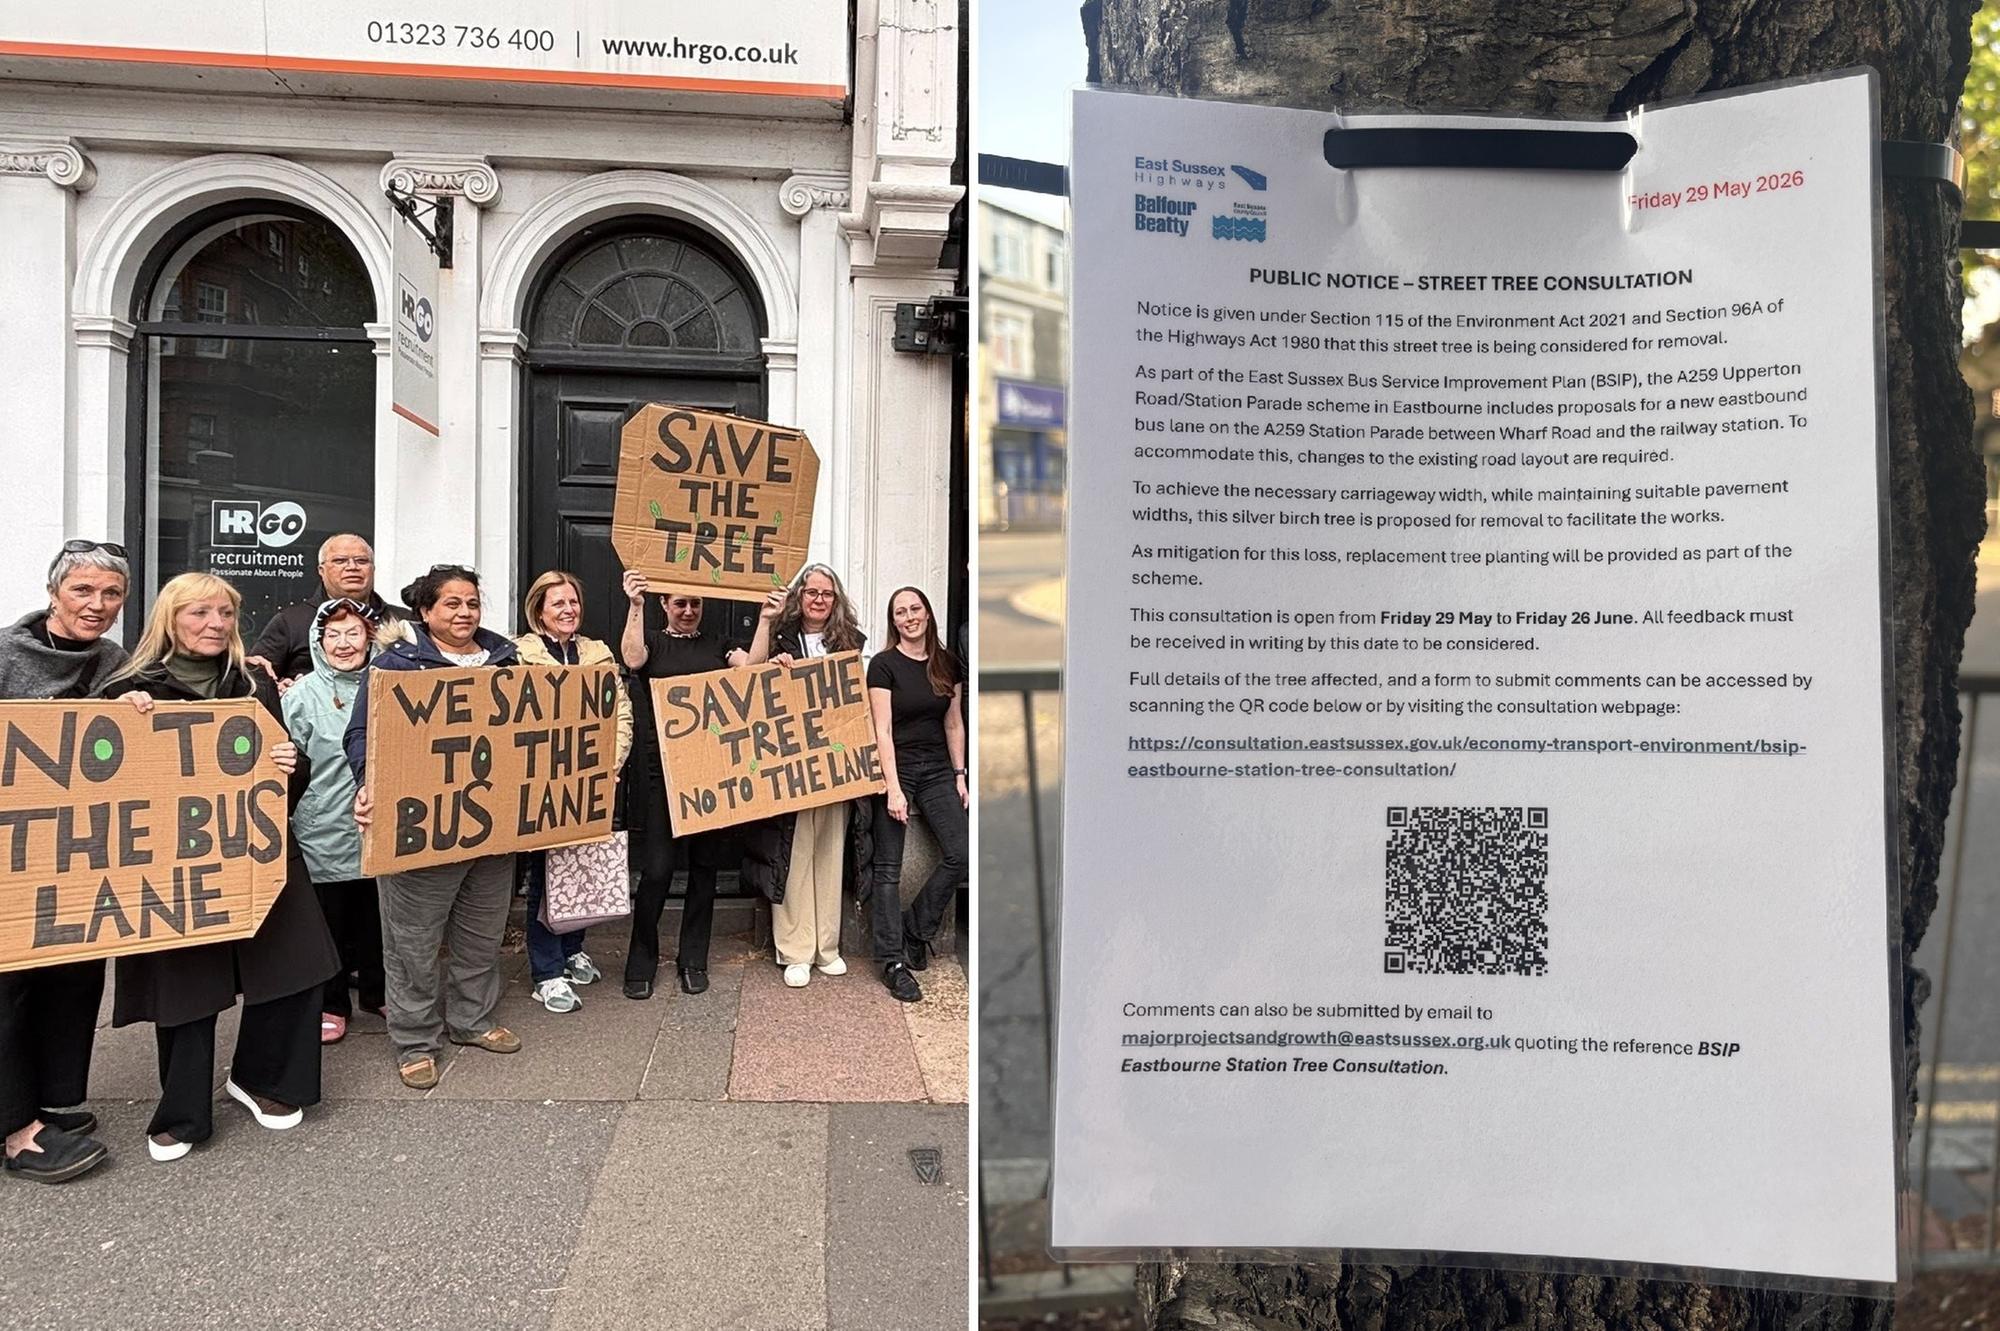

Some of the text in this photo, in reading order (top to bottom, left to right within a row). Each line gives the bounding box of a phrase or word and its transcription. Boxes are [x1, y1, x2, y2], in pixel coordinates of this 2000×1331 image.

[367, 21, 798, 66] 01323 736 400 www.hrgo.co.uk
[1135, 156, 1225, 177] East Sussex
[1135, 172, 1226, 191] Highways
[1135, 194, 1197, 216] Balfour
[1628, 170, 1804, 210] Friday 29 May 2026
[1135, 213, 1189, 237] Beatty
[1249, 267, 1322, 288] PUBLIC
[1326, 273, 1400, 291] NOTICE
[1417, 275, 1488, 291] STREET
[1491, 275, 1539, 292] TREE
[1543, 268, 1693, 292] CONSULTATION
[1137, 298, 1785, 329] Notice is given under Section 115 of the Environment Act 2021 and Section 96A of
[1135, 327, 1728, 357] the Highways Act 1980 that this street tree is being considered for removal.
[1135, 363, 1801, 393] As part of the East Sussex Bus Service Improvement Plan (BSIP), the A259 Upperton
[1135, 387, 1808, 417] Road/Station Parade scheme in Eastbourne includes proposals for a new eastbound
[650, 411, 797, 483] SAVE
[679, 479, 760, 519] THE
[1132, 479, 1789, 505] To achieve the necessary carriageway width, while maintaining suitable pavement
[210, 550, 304, 566] recruitment
[654, 518, 778, 574] TREE
[210, 567, 304, 580] Passionate About People
[1131, 570, 1203, 586] scheme.
[1129, 607, 1794, 628] This consultation is open from Friday 29 May to Friday 26 June. All feedback must
[392, 668, 616, 727] WE SAY NO
[664, 655, 863, 739] SAVE THE
[1129, 698, 1681, 718] scanning the QR code below or by visiting the consultation webpage:
[1, 711, 263, 790] NO TO
[719, 709, 830, 766] TREE
[1127, 735, 1807, 757] https://consultation.eastsussex.gov.uk/economy-transport-environment/bsip-
[431, 723, 601, 784] TO THE
[680, 744, 884, 820] NO TO THE LANE
[1127, 762, 1457, 778] eastbourne-station-tree-consultation/
[0, 779, 286, 873] THE BUS
[395, 771, 608, 857] BUS LANE
[32, 862, 230, 948] LANE
[1121, 1029, 1741, 1058] majorprojectsandgrowth@eastsussex.org.uk quoting the reference BSIP
[1120, 1056, 1448, 1075] Eastbourne Station Tree Consultation.
